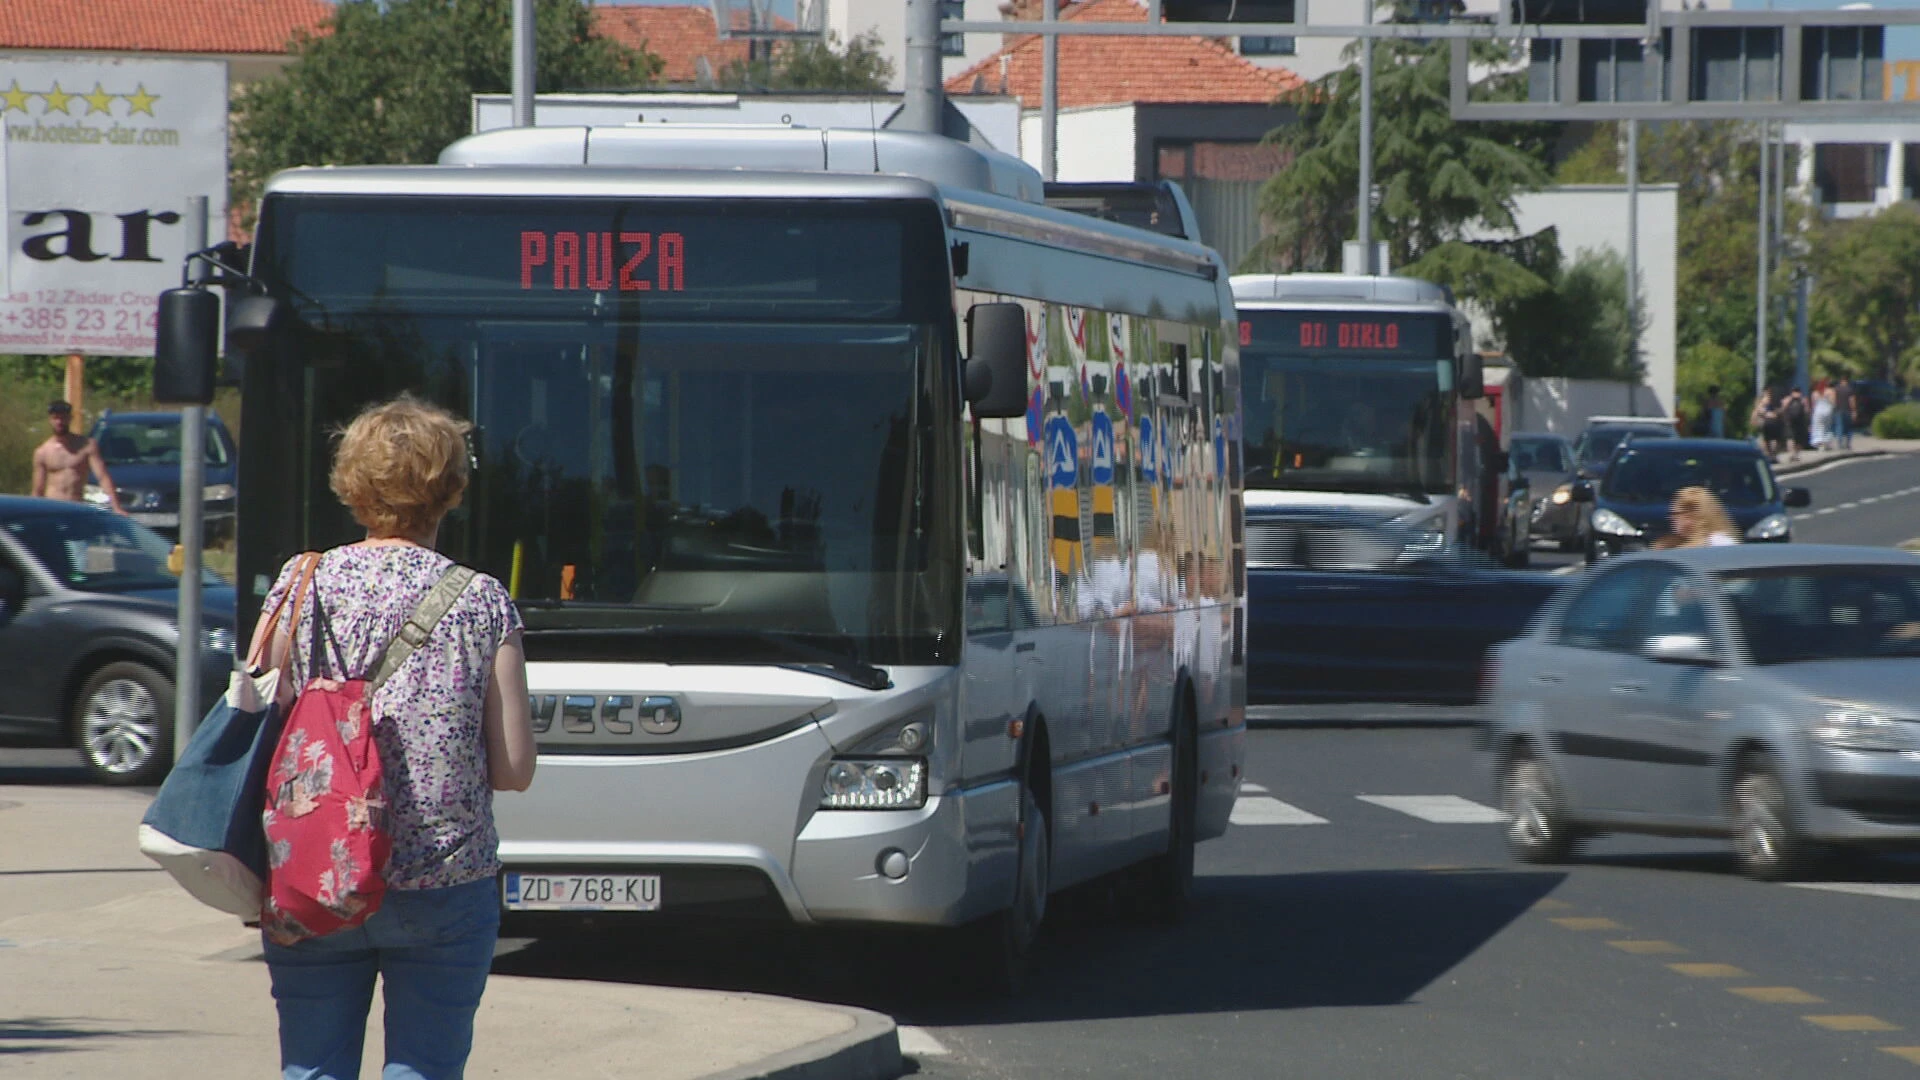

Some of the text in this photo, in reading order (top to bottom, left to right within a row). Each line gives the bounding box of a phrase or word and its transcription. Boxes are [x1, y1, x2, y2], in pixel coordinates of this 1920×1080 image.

[22, 208, 181, 263] ar
[520, 230, 685, 291] PAUZA
[77, 309, 106, 331] 23
[115, 309, 160, 333] 214
[1338, 322, 1399, 348] DIKLO
[522, 878, 656, 902] ZD 768-KU
